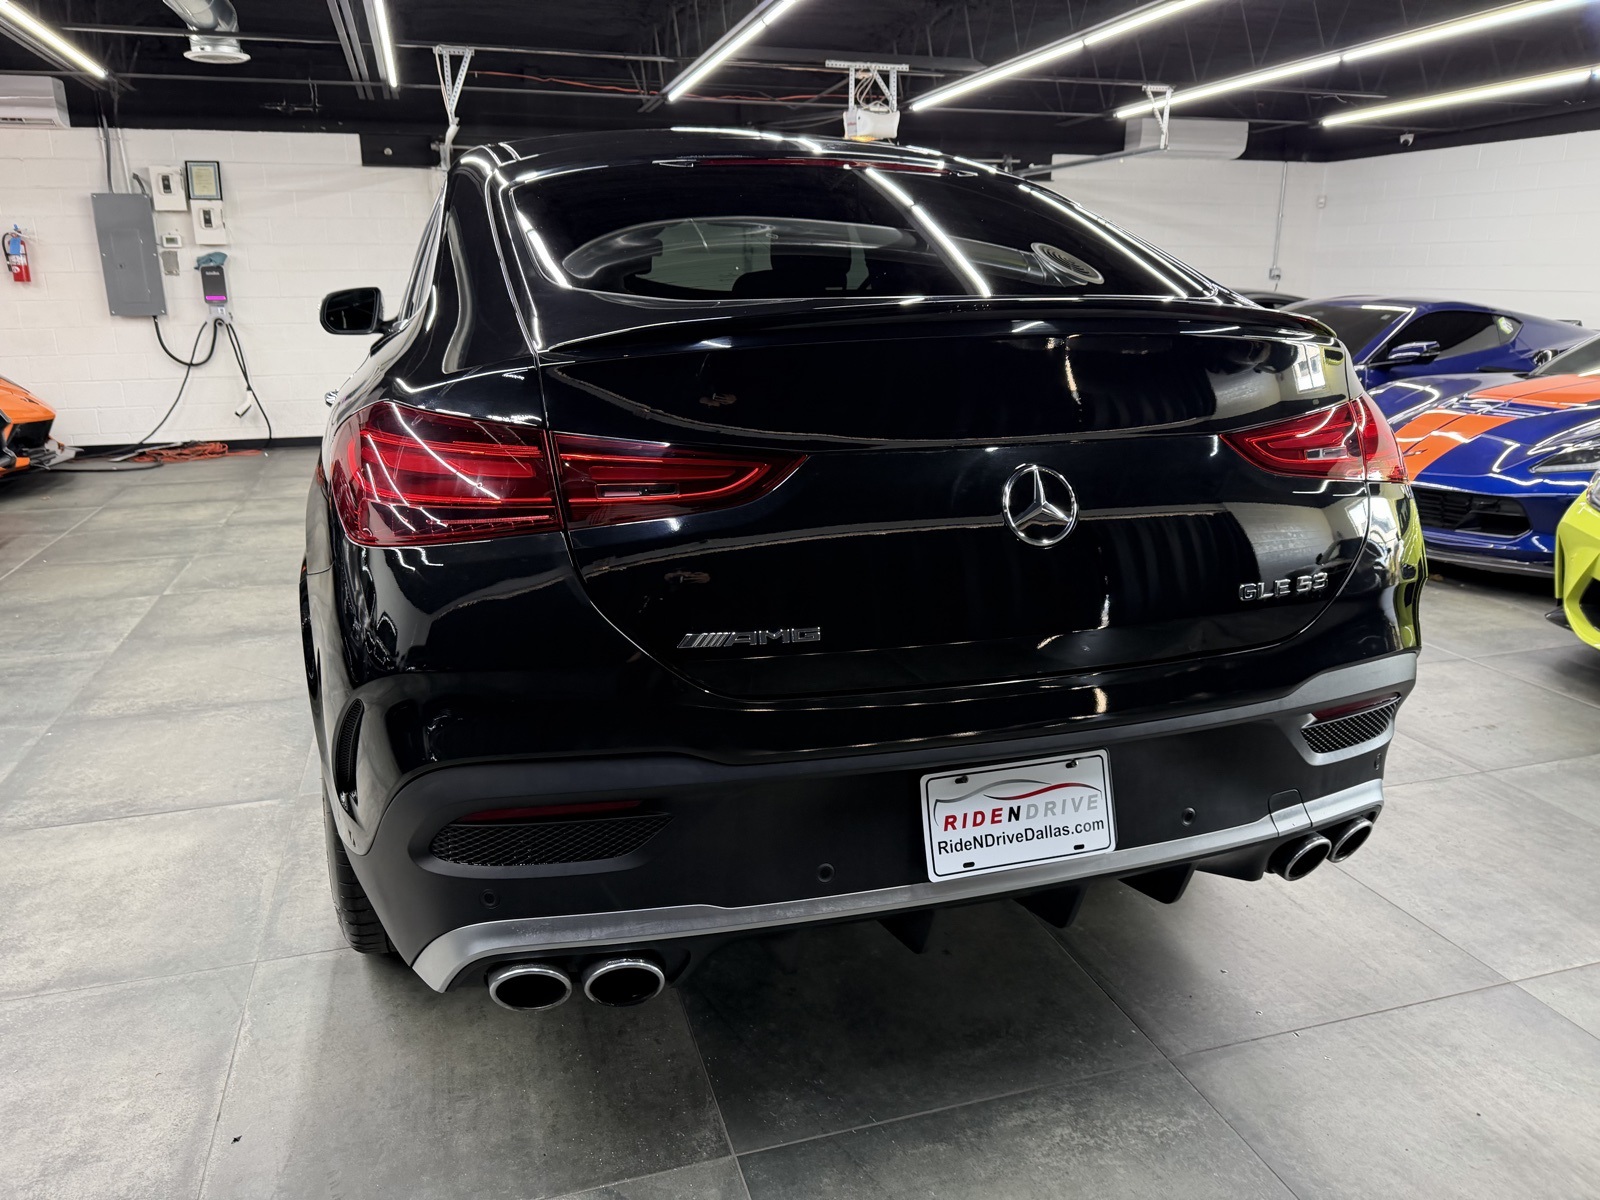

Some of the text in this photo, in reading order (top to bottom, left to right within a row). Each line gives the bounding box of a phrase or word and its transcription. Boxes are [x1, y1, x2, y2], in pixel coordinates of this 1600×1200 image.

[1239, 572, 1328, 601] GLE 53
[723, 626, 821, 647] AMG
[937, 819, 1105, 855] RideNDriveDallas.com
